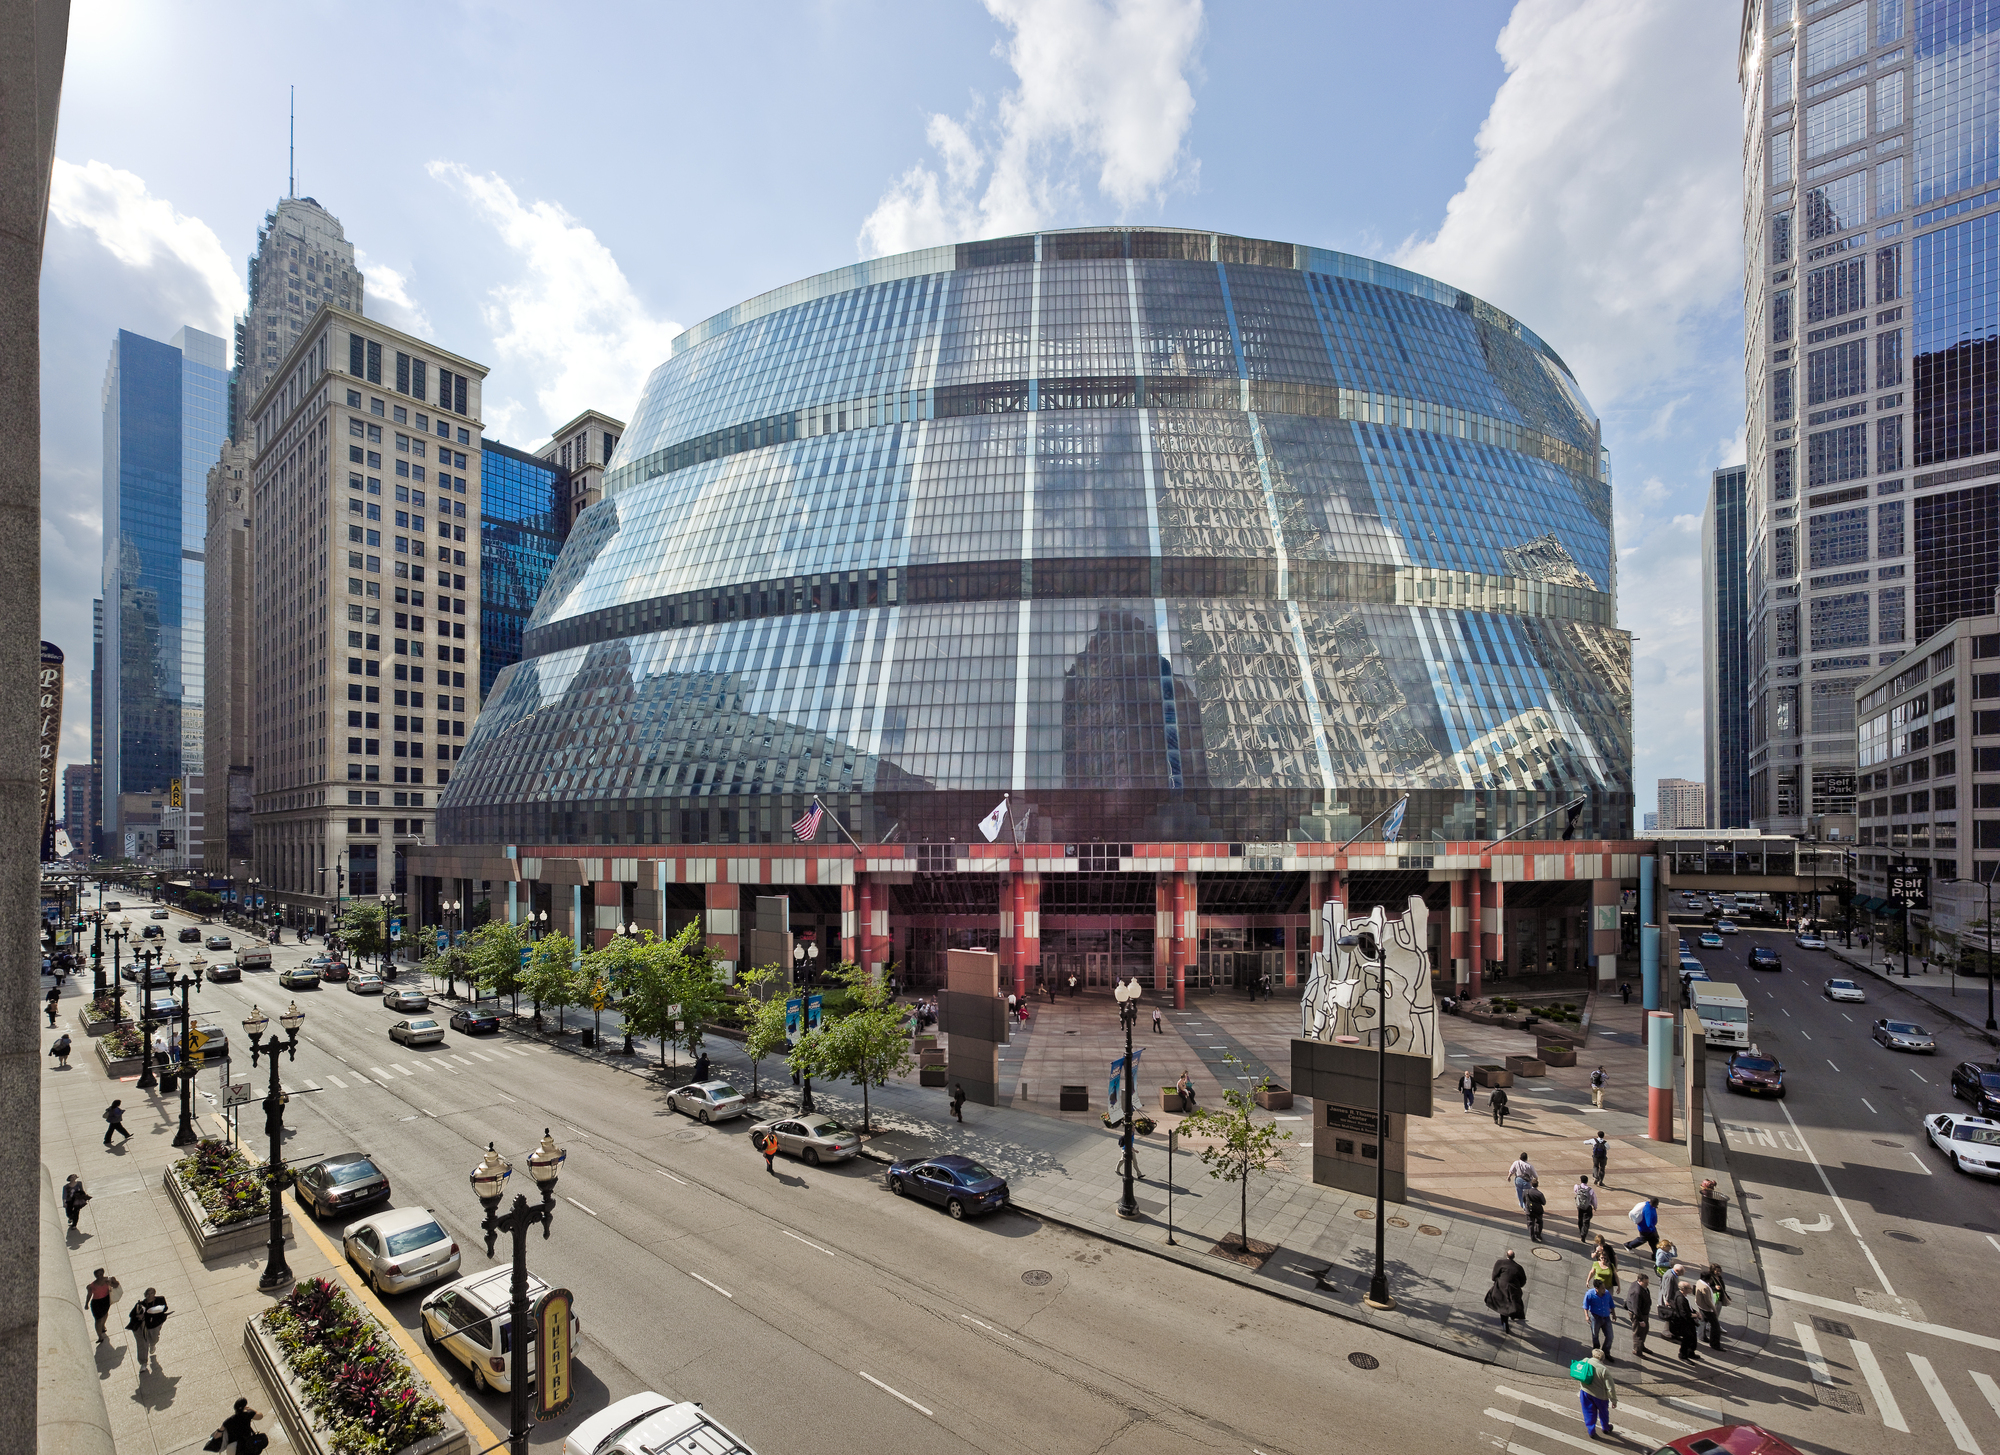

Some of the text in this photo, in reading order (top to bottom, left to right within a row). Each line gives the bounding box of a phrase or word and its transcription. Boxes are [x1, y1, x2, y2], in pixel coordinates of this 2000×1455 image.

[1828, 778, 1850, 786] Self
[172, 779, 180, 807] PARK
[1828, 785, 1852, 793] Park
[1893, 878, 1923, 888] Self
[1329, 1106, 1348, 1114] James
[1347, 1114, 1368, 1122] Center
[552, 1312, 561, 1401] THEATRE
